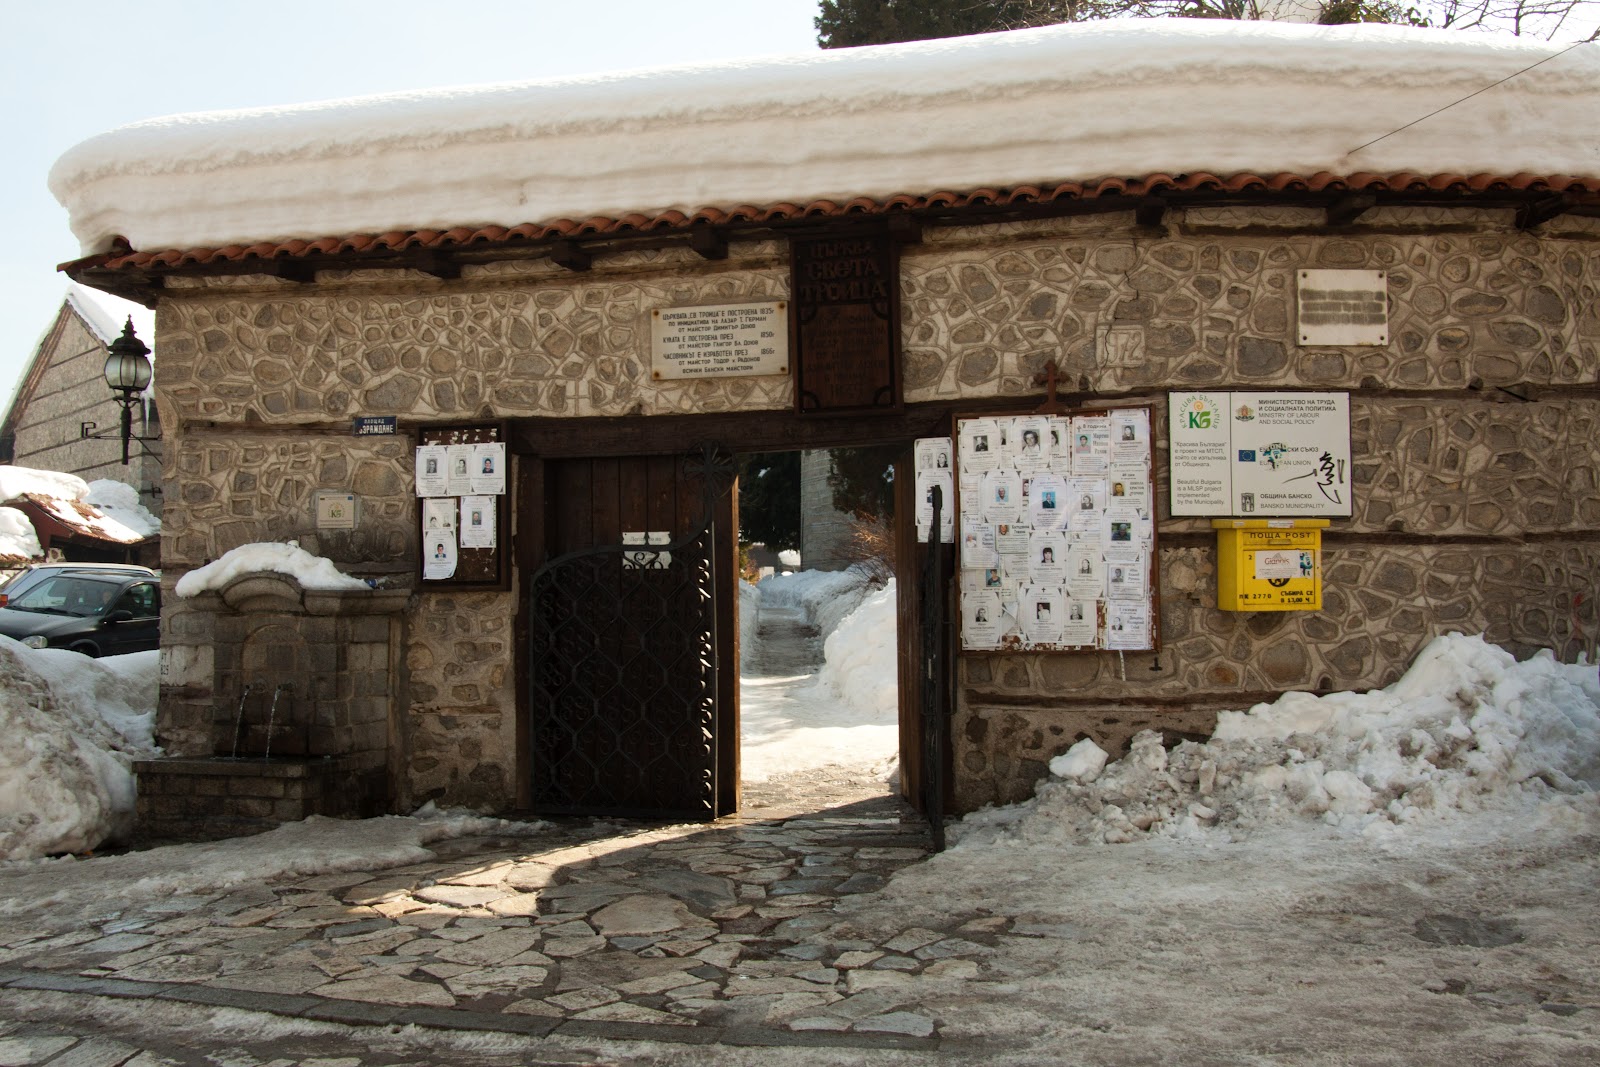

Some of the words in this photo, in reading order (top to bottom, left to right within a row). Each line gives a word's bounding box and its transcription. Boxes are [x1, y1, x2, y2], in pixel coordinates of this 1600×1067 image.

[727, 309, 758, 317] ПОСТРОЕНА
[688, 334, 718, 342] ПОСТРОЕНА
[703, 350, 733, 358] ИЗРАБОТЕН
